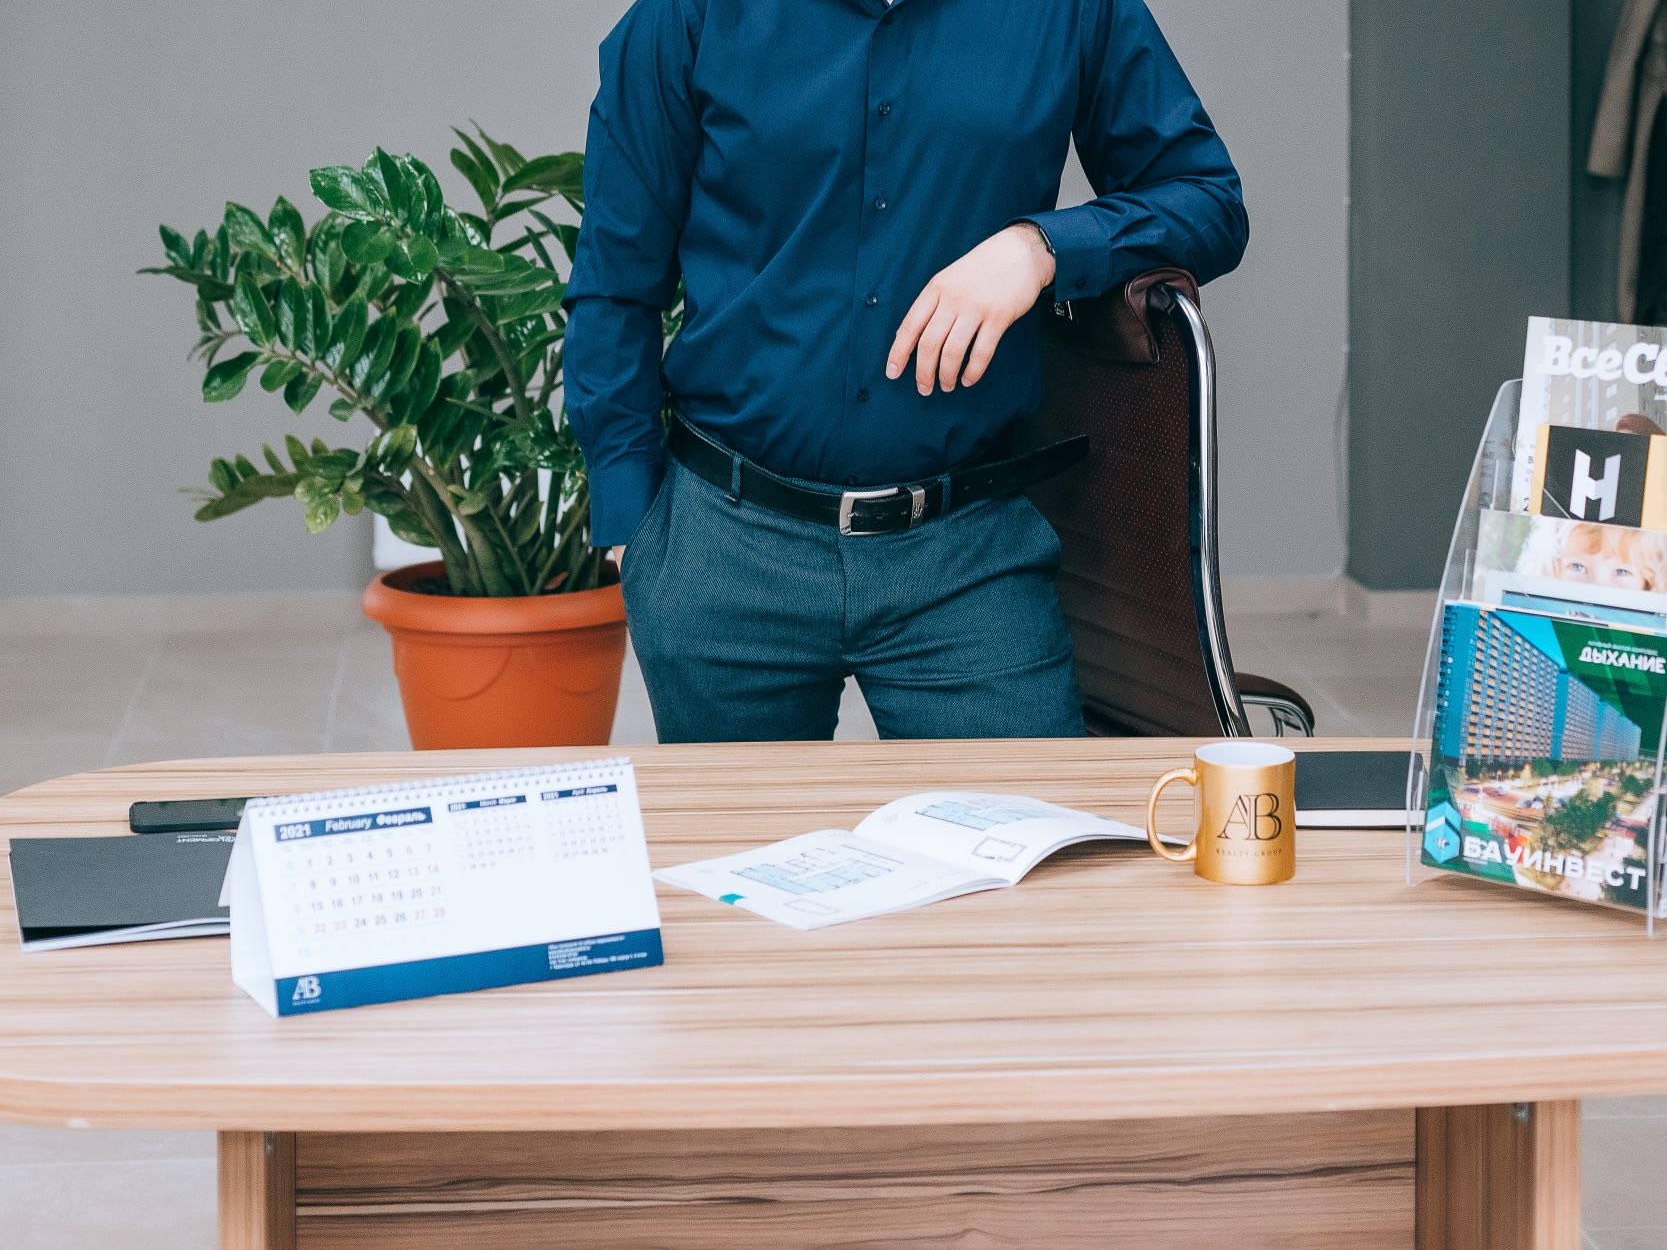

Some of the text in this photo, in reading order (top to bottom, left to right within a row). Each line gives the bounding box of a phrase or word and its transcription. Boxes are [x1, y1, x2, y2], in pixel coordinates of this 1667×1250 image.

[1578, 645, 1666, 675] ДЫХАНИЕ
[280, 812, 426, 839] 2021 February Февраль
[1216, 792, 1283, 841] AB
[1463, 835, 1647, 891] БАУИНВЕСТ
